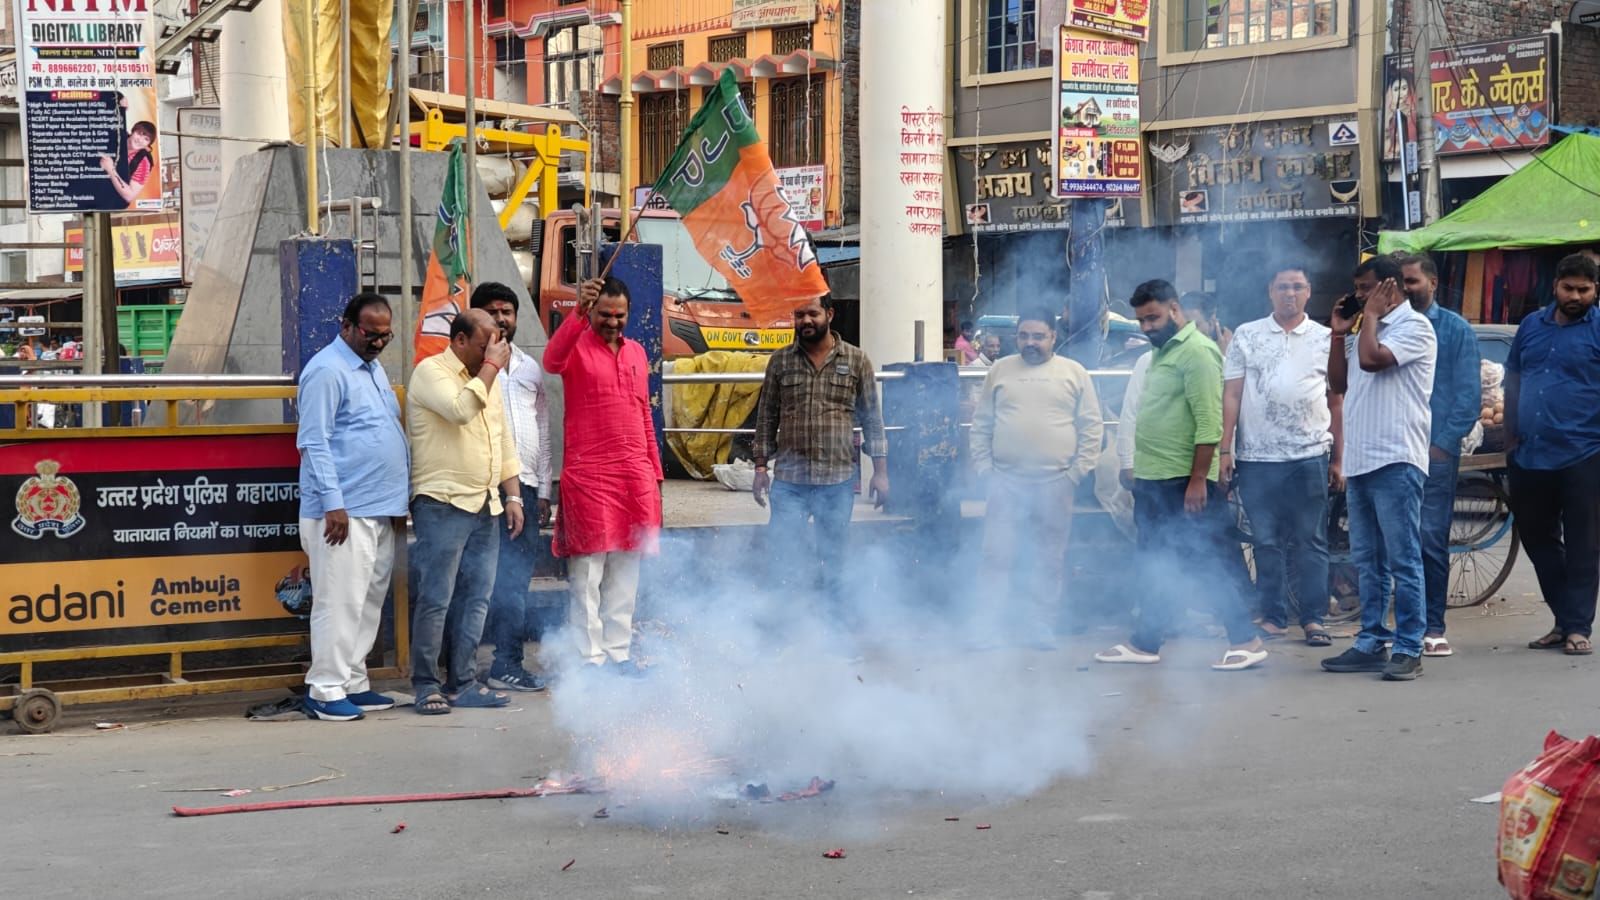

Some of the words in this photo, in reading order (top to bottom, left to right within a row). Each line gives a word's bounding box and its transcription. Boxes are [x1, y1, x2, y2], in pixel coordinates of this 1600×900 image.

[32, 23, 83, 42] DIGITAL
[87, 23, 142, 42] LIBRARY
[1065, 34, 1084, 54] केशव
[1086, 40, 1102, 55] नगर
[28, 77, 42, 88] PSM
[90, 76, 98, 88] के
[1460, 68, 1485, 108] के.
[1489, 57, 1546, 105] ज्वैलर्स
[707, 331, 720, 341] ON
[97, 486, 138, 508] उत्तर
[140, 478, 180, 510] प्रदेश
[183, 476, 228, 516] पुलिस
[113, 527, 171, 543] यातायात
[174, 521, 219, 541] नियमों
[220, 525, 240, 539] का
[243, 524, 281, 539] पालन
[151, 575, 241, 597] Ambuja
[8, 580, 125, 624] adani
[150, 596, 242, 616] Cement
